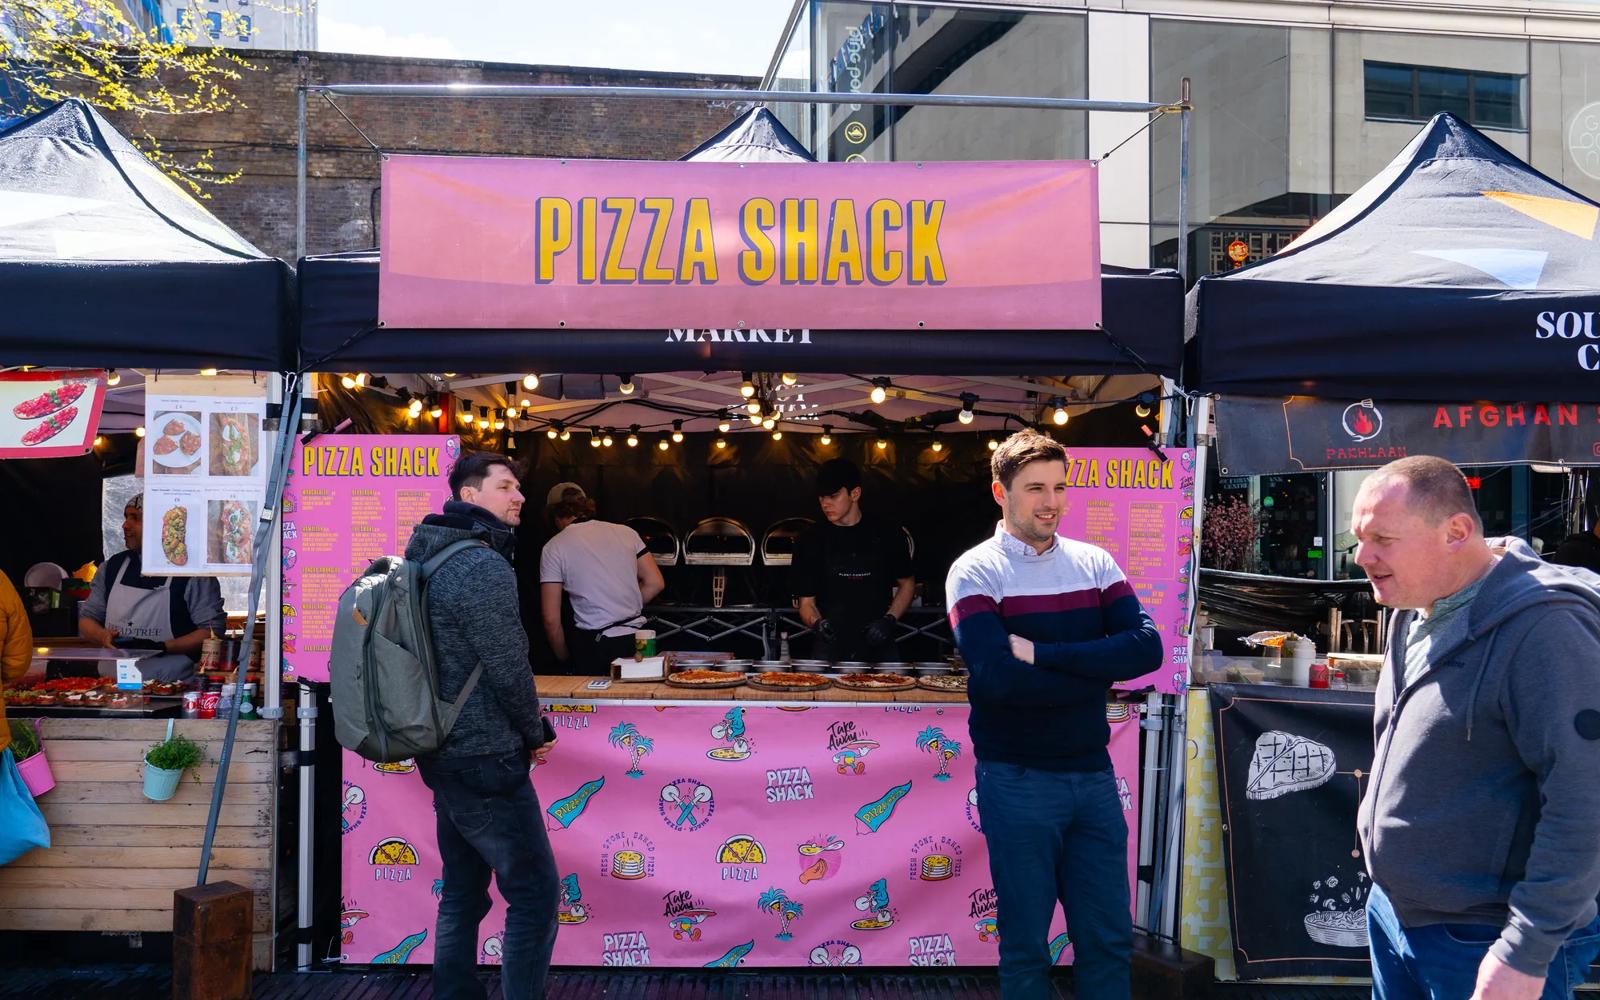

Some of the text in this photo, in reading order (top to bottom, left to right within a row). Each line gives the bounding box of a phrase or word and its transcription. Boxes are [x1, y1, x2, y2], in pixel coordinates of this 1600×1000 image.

[535, 196, 948, 287] PIZZA SHACK
[1432, 403, 1579, 429] AFGHAN
[303, 446, 364, 476] PIZZA
[370, 446, 440, 477] SHACK
[1065, 458, 1175, 489] ZZA SHACK
[135, 628, 162, 637] TREE
[552, 715, 590, 730] PIZZA
[827, 720, 856, 738] Take
[827, 731, 858, 750] Away
[766, 767, 811, 786] PIZZA
[766, 784, 814, 803] SHACK
[374, 867, 412, 882] PIZZA
[721, 866, 759, 882] PIZZA
[663, 890, 692, 906] Take
[663, 901, 694, 917] Away
[603, 931, 647, 951] PIZZA
[909, 934, 953, 954] PIZZA
[602, 948, 650, 966] SHACK
[908, 951, 956, 967] SHACK
